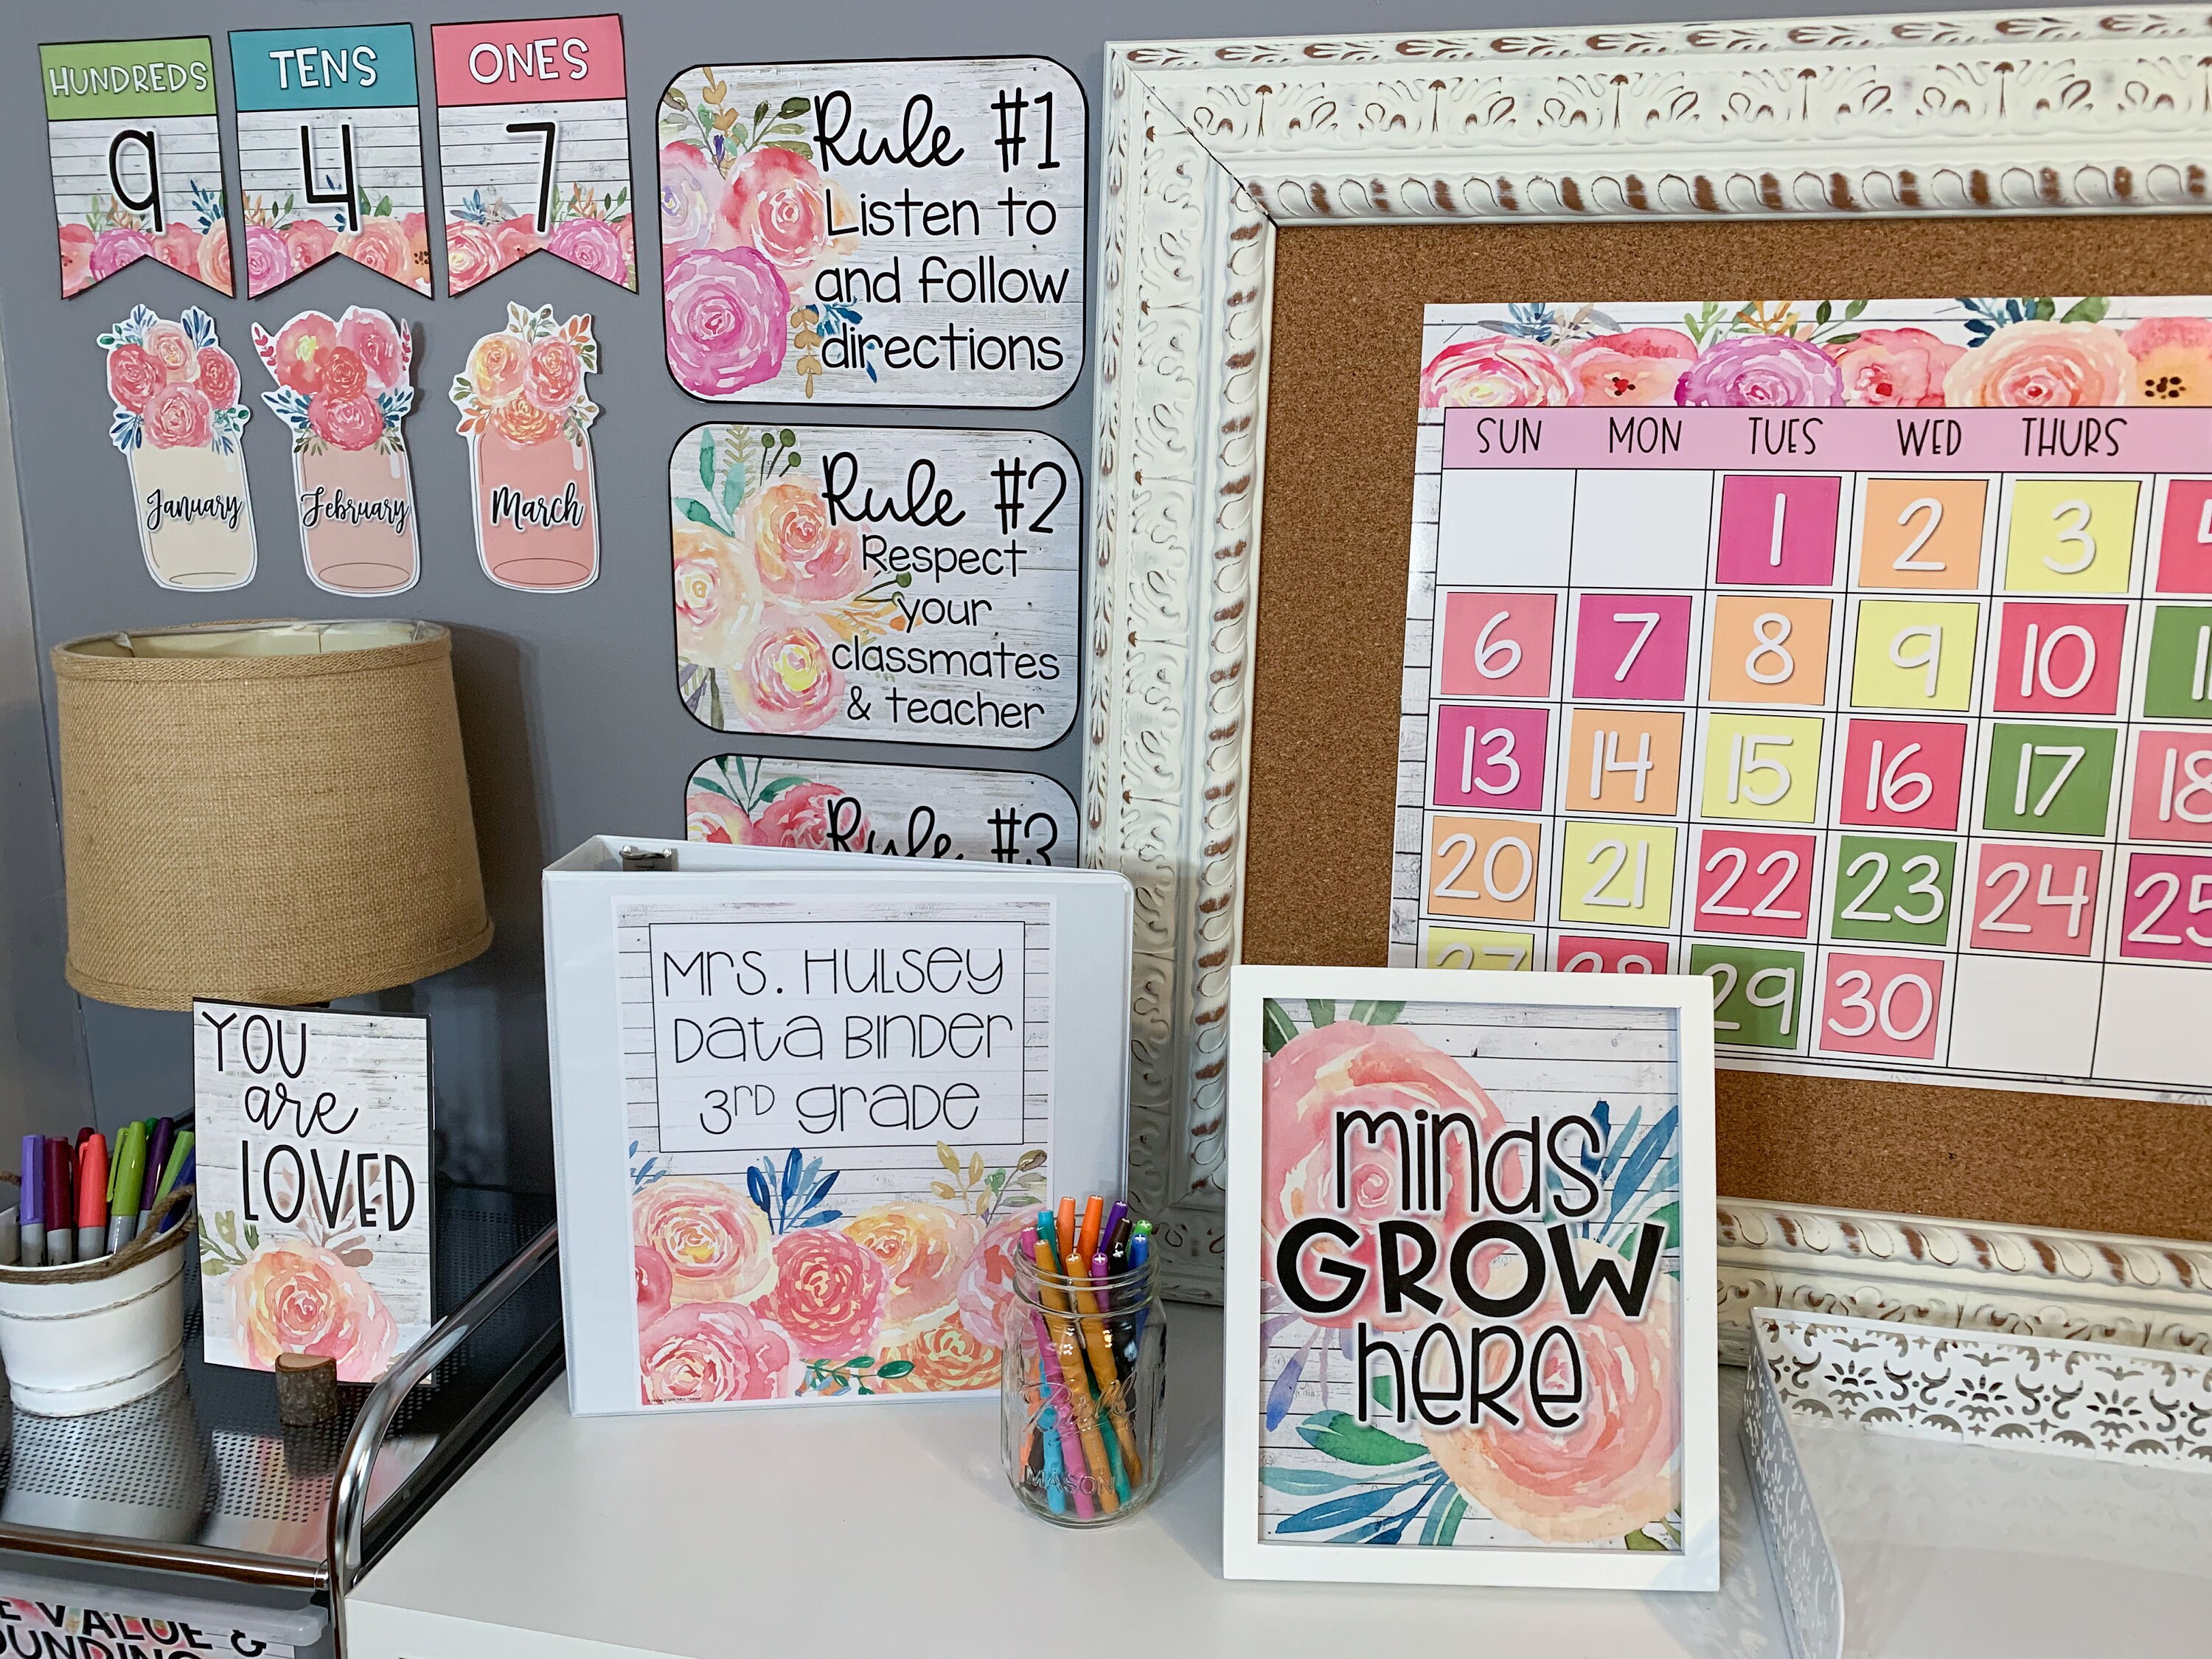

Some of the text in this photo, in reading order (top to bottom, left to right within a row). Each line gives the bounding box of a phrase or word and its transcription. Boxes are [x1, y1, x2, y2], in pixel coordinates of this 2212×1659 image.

[50, 63, 206, 95] HUNDREDS
[270, 46, 375, 88] TENS
[470, 39, 587, 83] ONES
[813, 88, 1060, 173] Rule #1
[109, 130, 162, 232] 9
[302, 125, 358, 231] 4
[506, 122, 555, 232] 7
[826, 187, 1056, 237] Listen to
[815, 256, 1069, 303] and follow
[822, 323, 1062, 370] directions
[1478, 417, 2126, 456] SUN MON TUES WED THURS
[147, 489, 242, 529] January
[301, 487, 408, 533] February
[493, 483, 584, 528] March
[822, 452, 1066, 535] Rule #2
[1770, 493, 2095, 572] 1 2 3
[863, 535, 1027, 582] Respect
[897, 599, 992, 633] your
[832, 636, 1059, 680] classmates
[1475, 611, 1521, 678] 6
[1614, 613, 1659, 681] 7
[1746, 613, 1792, 683] 8
[1890, 625, 1940, 695] 9
[2022, 624, 2095, 697] 10
[848, 686, 1044, 728] & teacher
[1462, 726, 2212, 822] 13 14 15 16 17 18
[827, 797, 1057, 866] Rule #3
[1434, 832, 2212, 947] 20 21 22 23 24 25
[664, 951, 782, 996] Mrs.
[1714, 963, 1933, 1040] 29 30
[202, 1011, 307, 1078] YOU
[246, 1082, 358, 1138] are
[243, 1141, 414, 1231] LOVED
[1337, 1110, 1599, 1217] minds
[1277, 1218, 1664, 1317] GROW
[1024, 1464, 1116, 1495] MASON
[35, 1601, 212, 1649] VALUE
